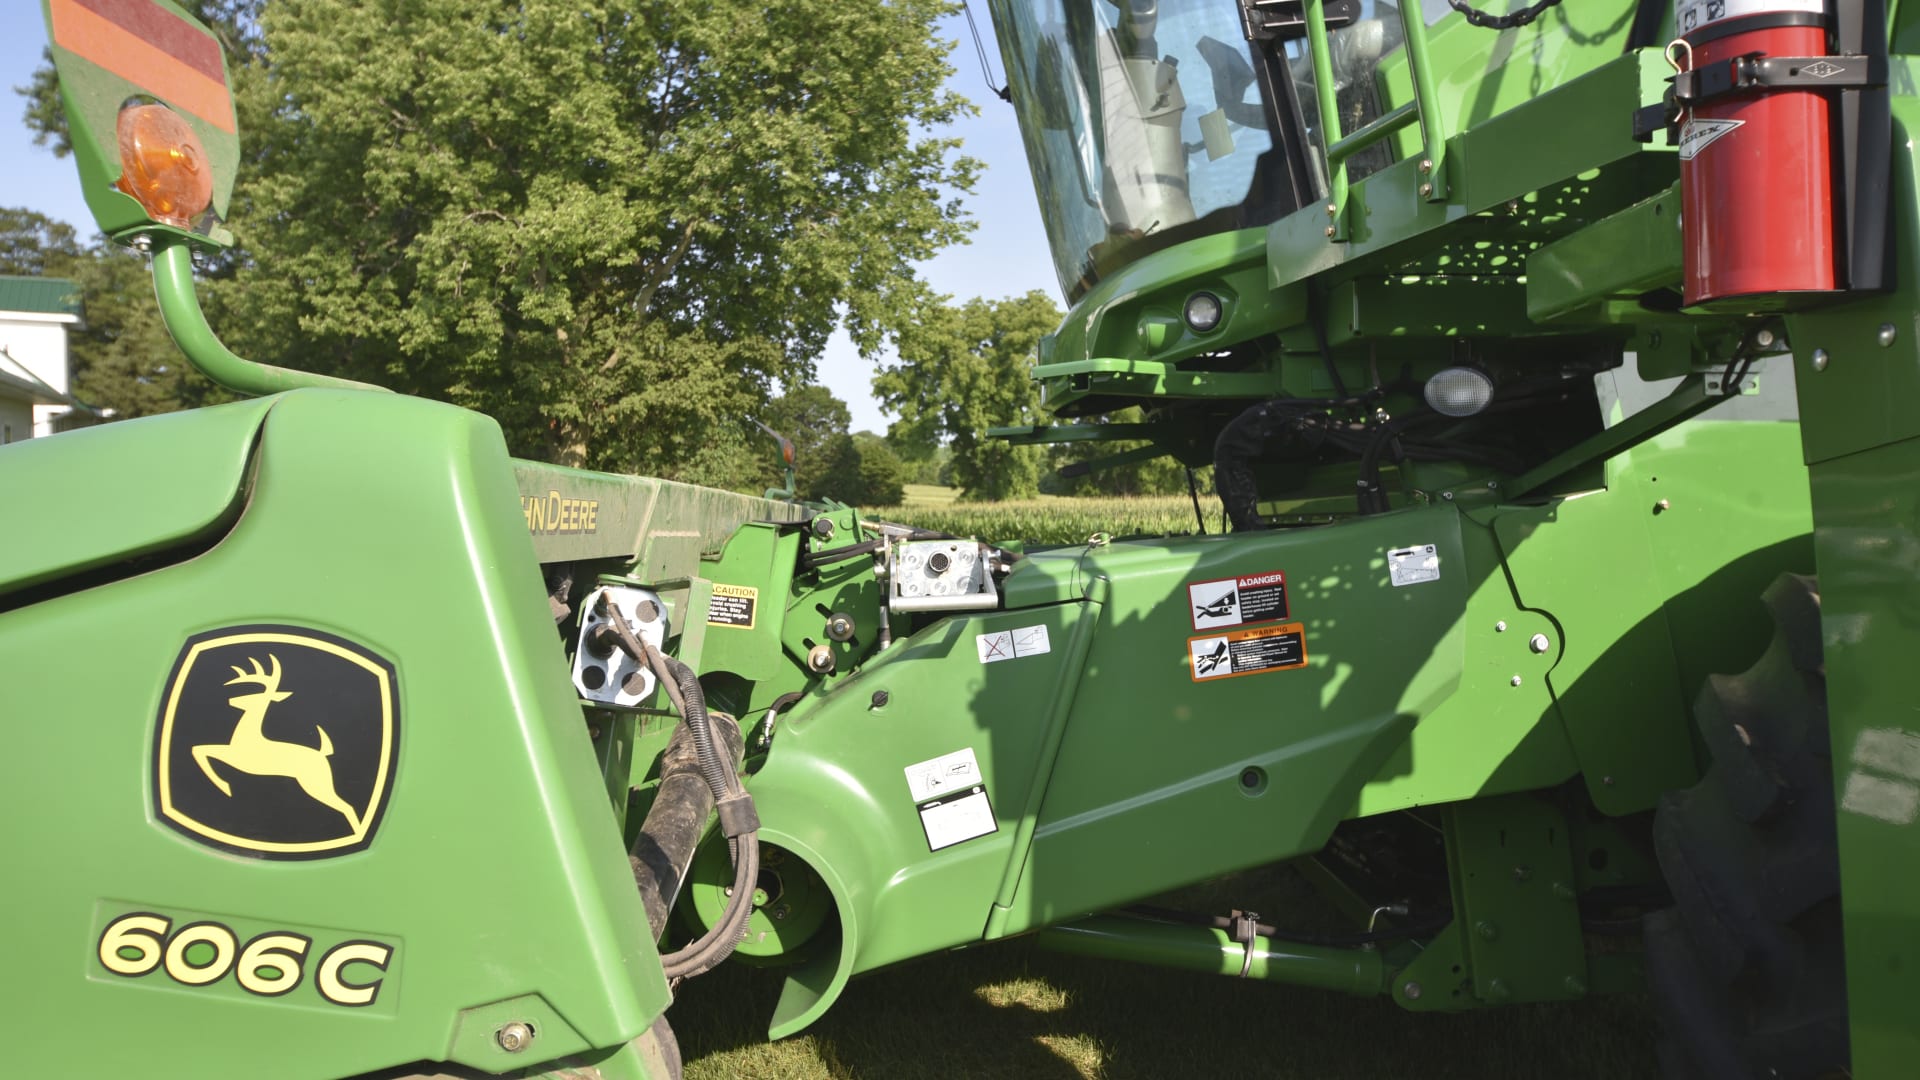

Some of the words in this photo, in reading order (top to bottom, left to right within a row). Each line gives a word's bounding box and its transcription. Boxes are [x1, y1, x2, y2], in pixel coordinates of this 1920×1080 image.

[521, 496, 547, 532] HN
[546, 489, 599, 533] DEERE
[1246, 574, 1282, 586] DANGER
[715, 585, 755, 597] CAUTION
[1252, 626, 1288, 636] WARNING
